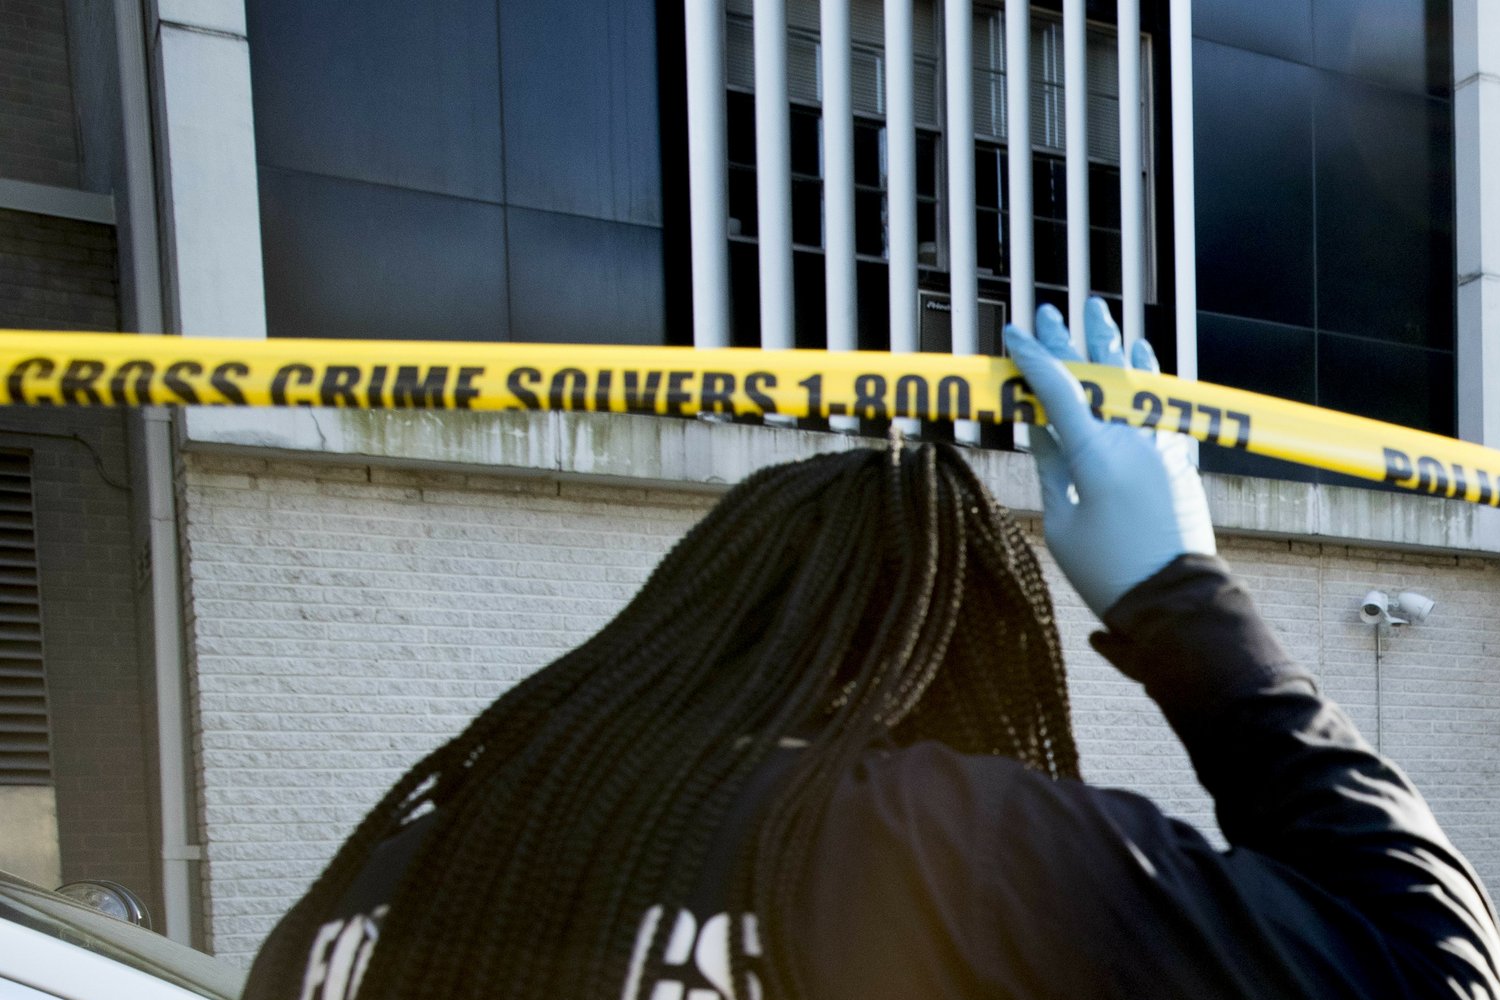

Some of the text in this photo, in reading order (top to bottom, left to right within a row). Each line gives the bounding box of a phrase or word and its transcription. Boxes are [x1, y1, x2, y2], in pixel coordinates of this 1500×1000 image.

[8, 357, 250, 406] CROSS
[270, 361, 486, 409] CRIME
[506, 366, 777, 416] SOLVERS
